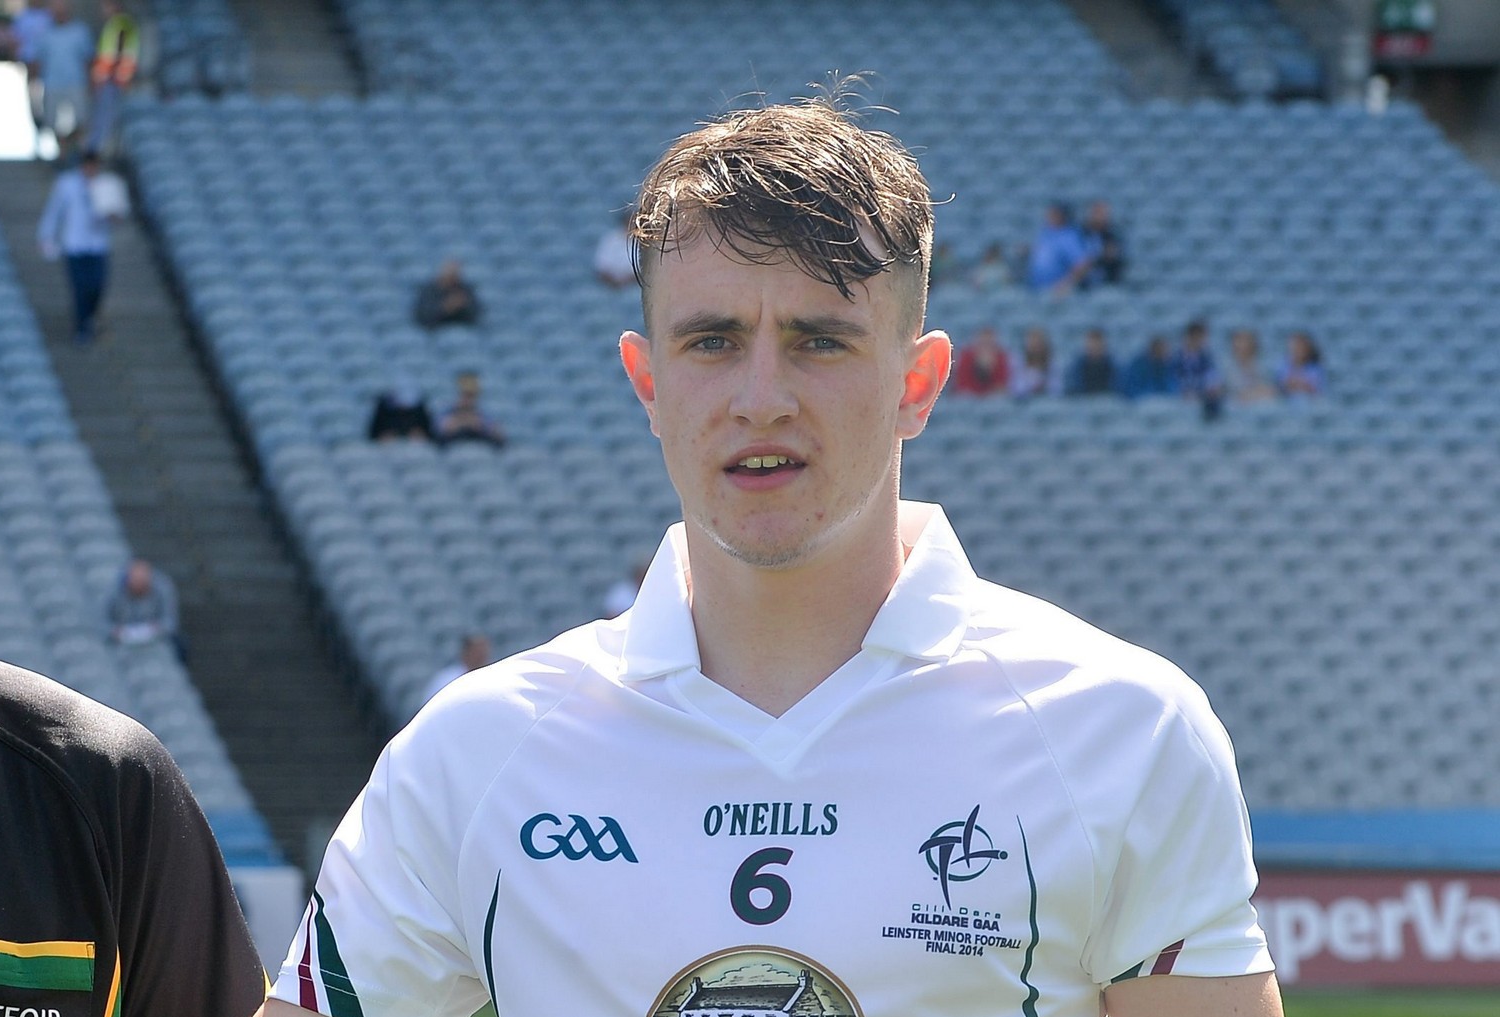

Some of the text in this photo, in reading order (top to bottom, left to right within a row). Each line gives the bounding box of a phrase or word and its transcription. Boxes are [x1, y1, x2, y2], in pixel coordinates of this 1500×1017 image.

[703, 802, 838, 836] O'NEILLS
[520, 813, 639, 863] GAA
[730, 846, 794, 926] 6
[911, 912, 1001, 932] KILDARE GAA
[959, 907, 1001, 919] Dara
[882, 926, 1022, 949] LEINSTER MINOR FOOTBALL
[925, 941, 984, 957] FINAL 2014
